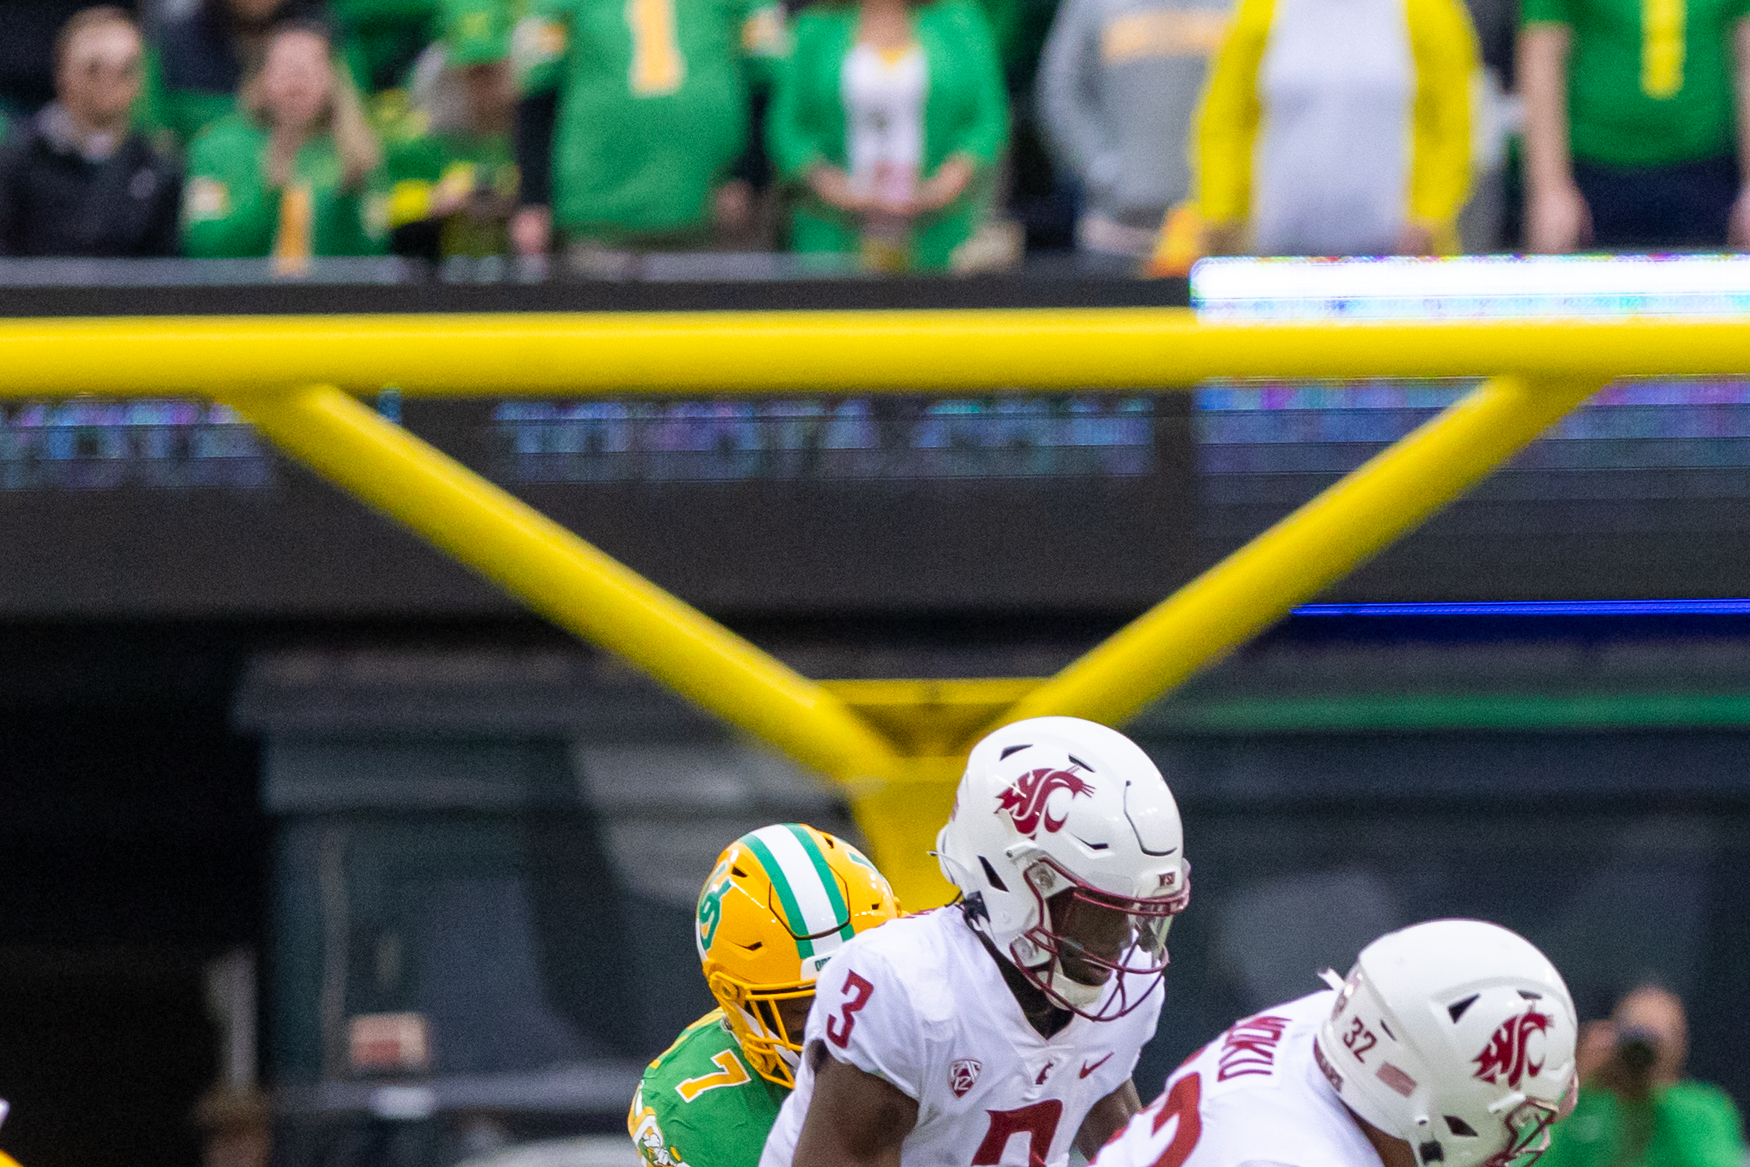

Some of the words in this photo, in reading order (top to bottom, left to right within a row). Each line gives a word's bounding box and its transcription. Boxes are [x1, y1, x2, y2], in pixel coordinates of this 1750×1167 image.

[825, 968, 875, 1050] 3
[1342, 1015, 1378, 1064] 32
[674, 1048, 752, 1104] 7
[953, 1075, 971, 1091] 12
